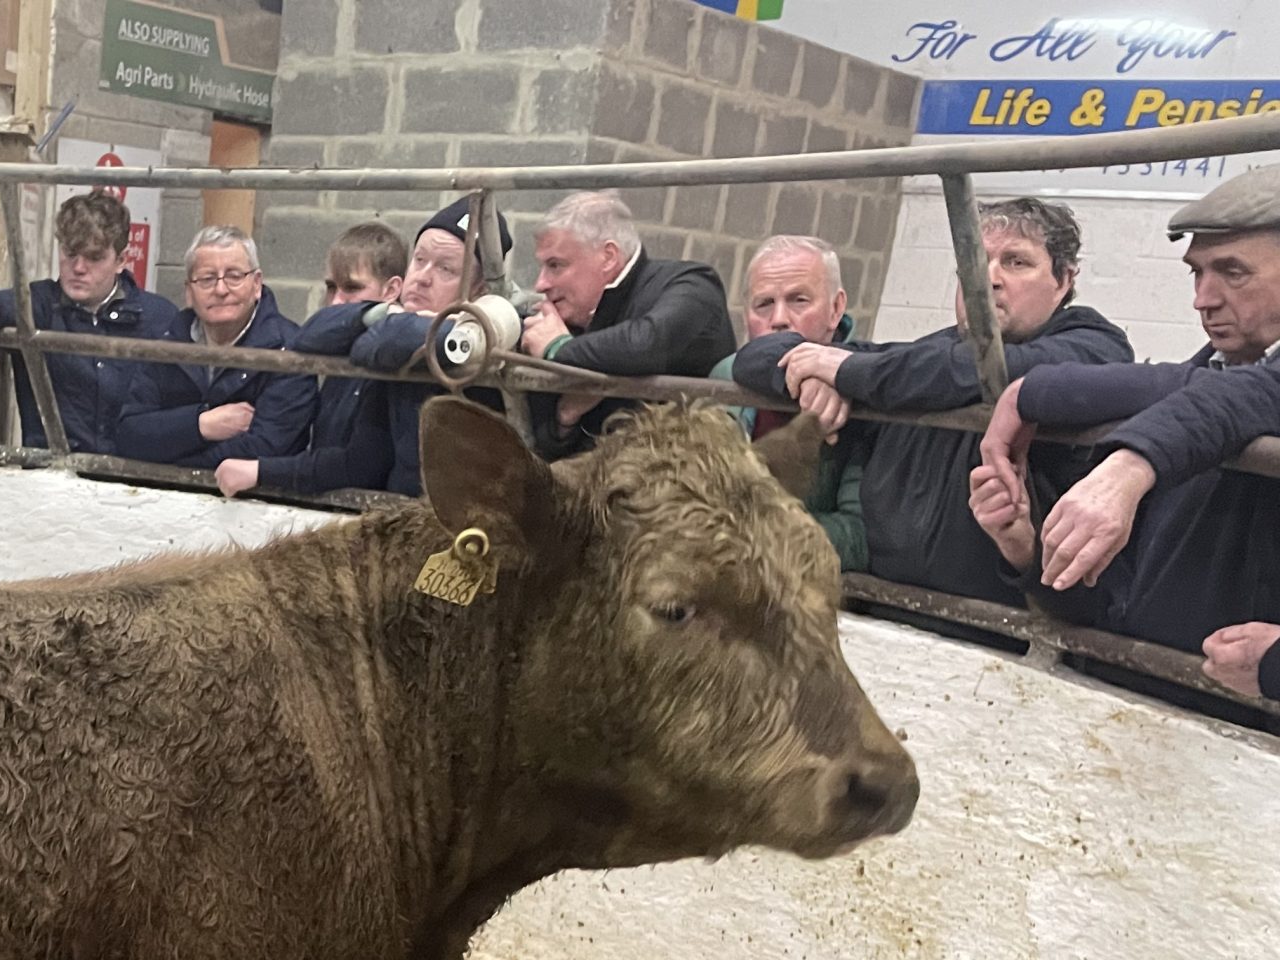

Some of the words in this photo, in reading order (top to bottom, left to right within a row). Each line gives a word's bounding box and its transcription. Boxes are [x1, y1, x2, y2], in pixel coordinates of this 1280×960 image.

[118, 18, 150, 40] ALSO
[151, 25, 210, 54] SUPPLYING
[891, 19, 977, 63] For
[989, 16, 1098, 63] All
[1116, 17, 1237, 74] Your
[115, 61, 142, 88] Agri
[143, 66, 174, 90] Parts
[188, 74, 242, 102] Hydraulic
[243, 85, 269, 108] Hose
[968, 86, 1052, 127] Life
[1068, 87, 1108, 128] &
[418, 567, 477, 604] 30366
